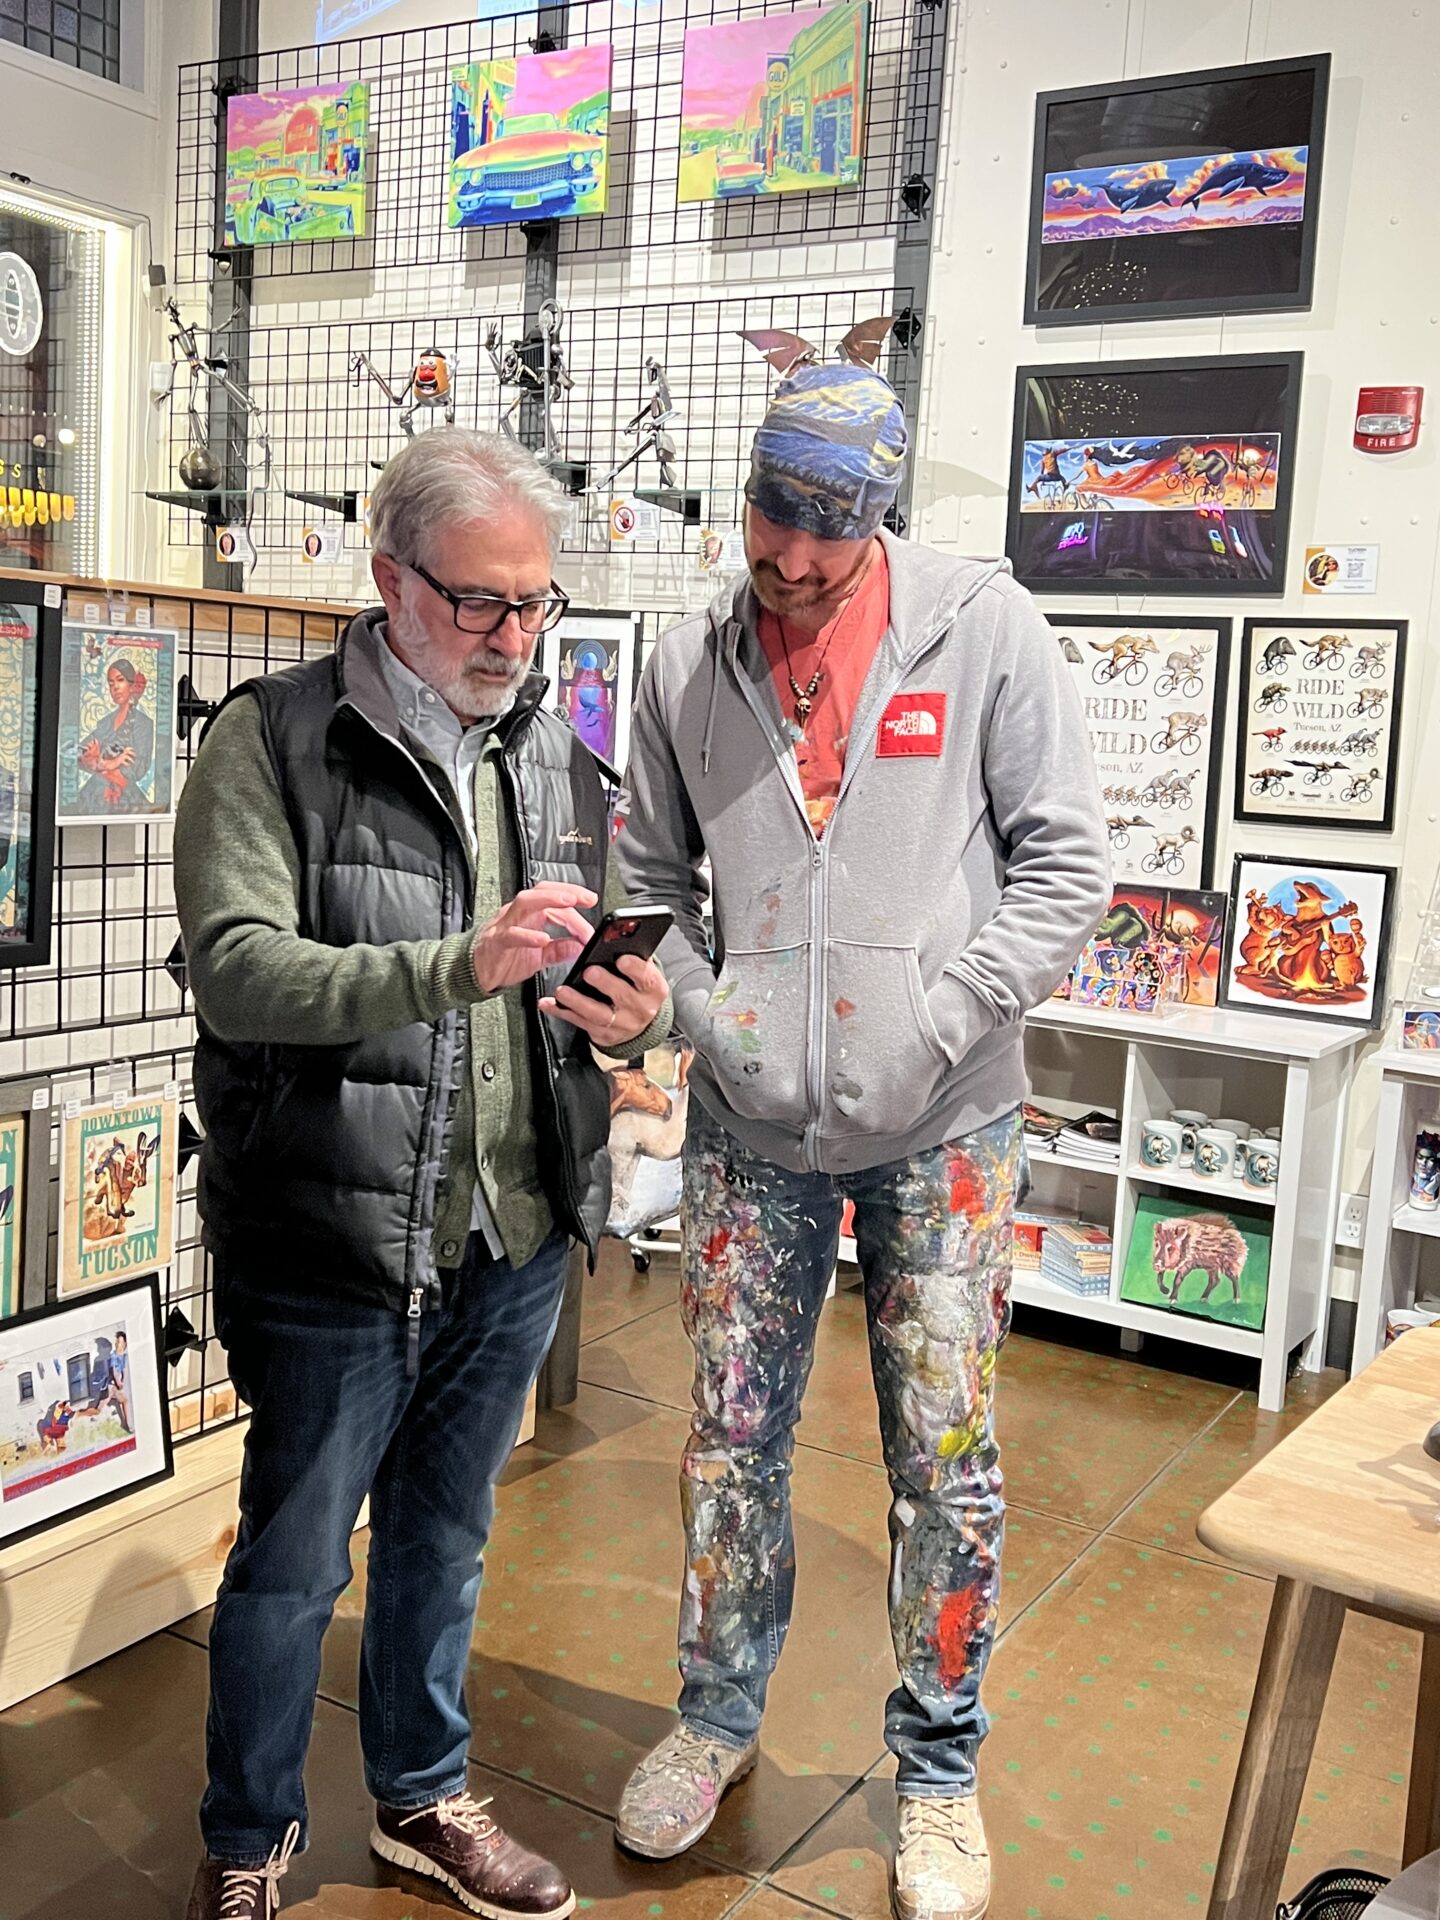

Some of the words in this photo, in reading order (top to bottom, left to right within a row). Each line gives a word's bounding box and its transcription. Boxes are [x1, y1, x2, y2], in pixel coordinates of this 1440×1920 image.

[769, 71, 786, 82] GULF
[1367, 437, 1396, 447] FIRE
[157, 651, 172, 736] ARIZONA
[1297, 678, 1345, 695] RIDE
[901, 711, 920, 720] THE
[1084, 697, 1147, 721] RIDE
[1292, 702, 1345, 719] WILD
[885, 719, 920, 730] NORTH
[894, 727, 920, 737] FACE
[1127, 762, 1144, 774] AZ
[81, 1104, 162, 1131] DOWNTOWN
[81, 1234, 158, 1280] TUCSON
